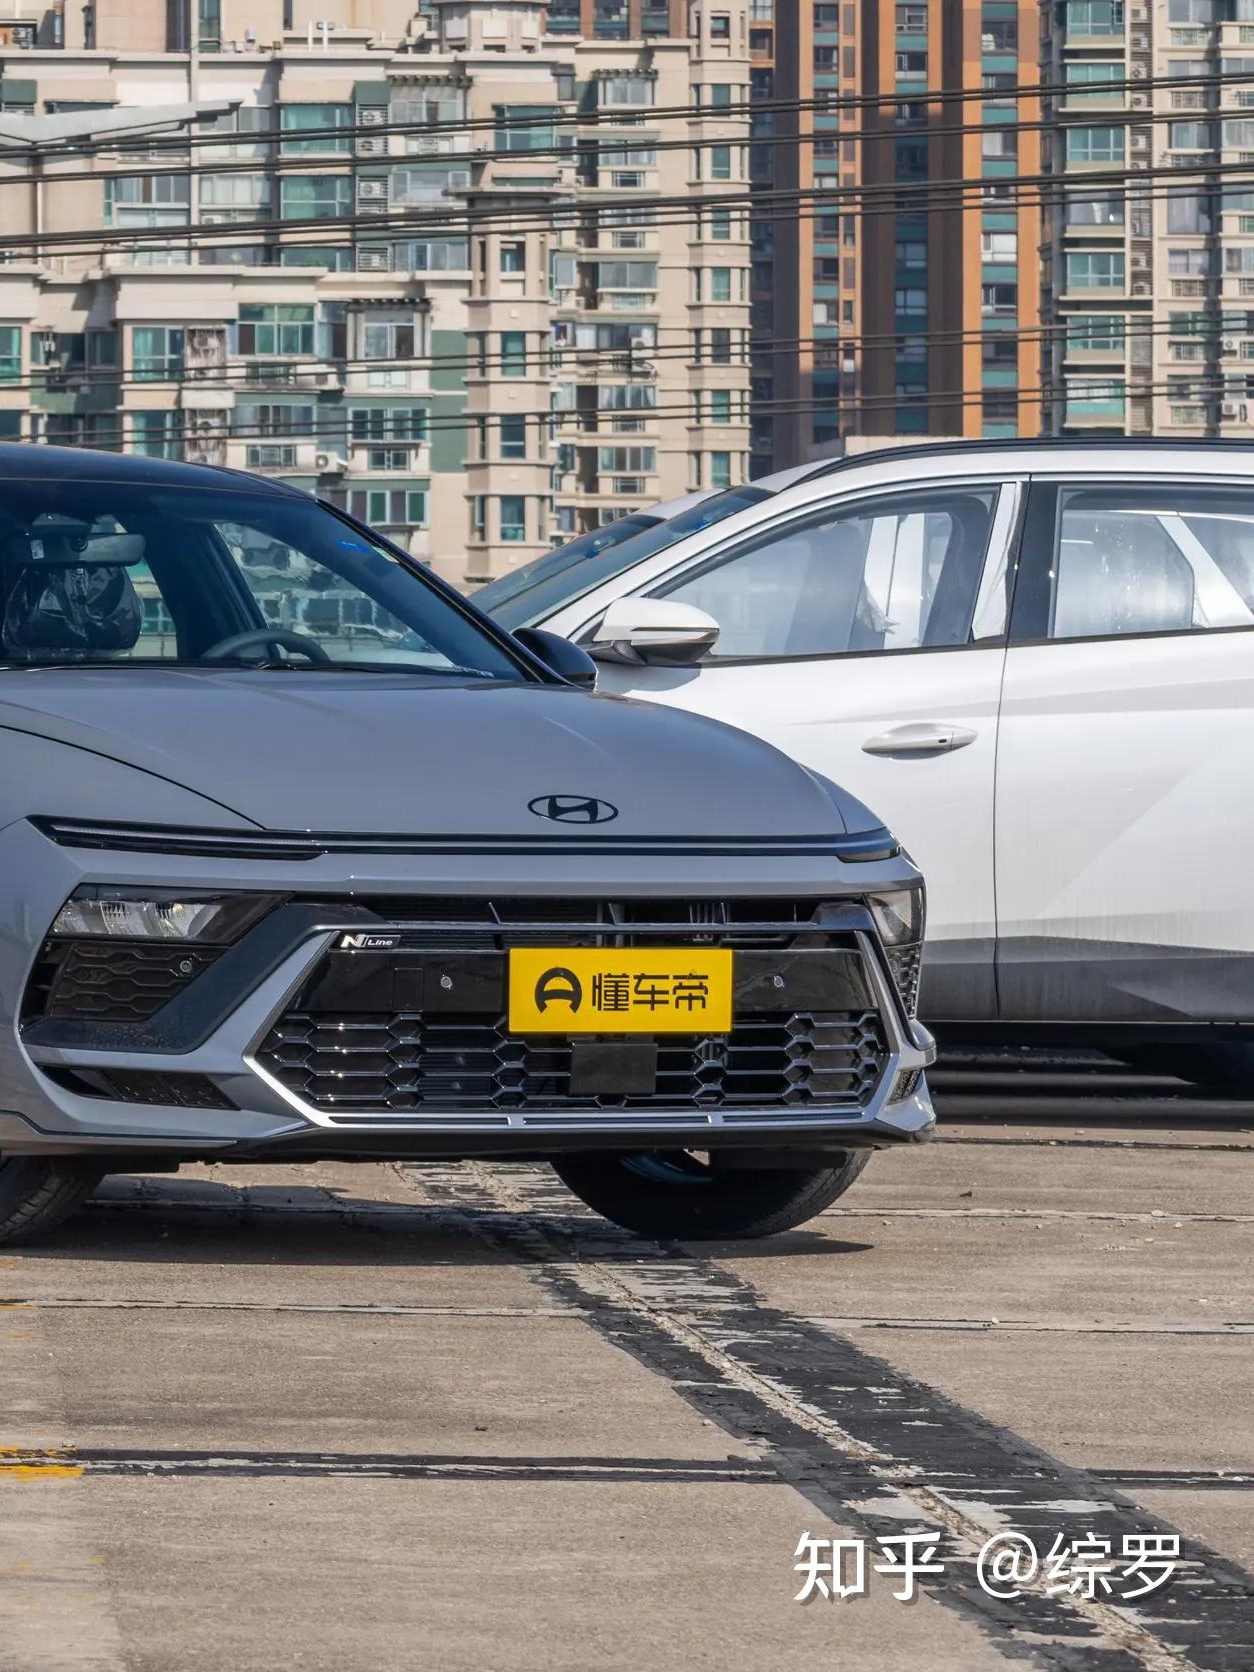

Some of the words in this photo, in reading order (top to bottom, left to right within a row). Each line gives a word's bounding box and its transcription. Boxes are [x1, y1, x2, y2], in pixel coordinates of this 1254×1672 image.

[340, 934, 366, 948] N
[591, 973, 709, 1012] 懂车帝
